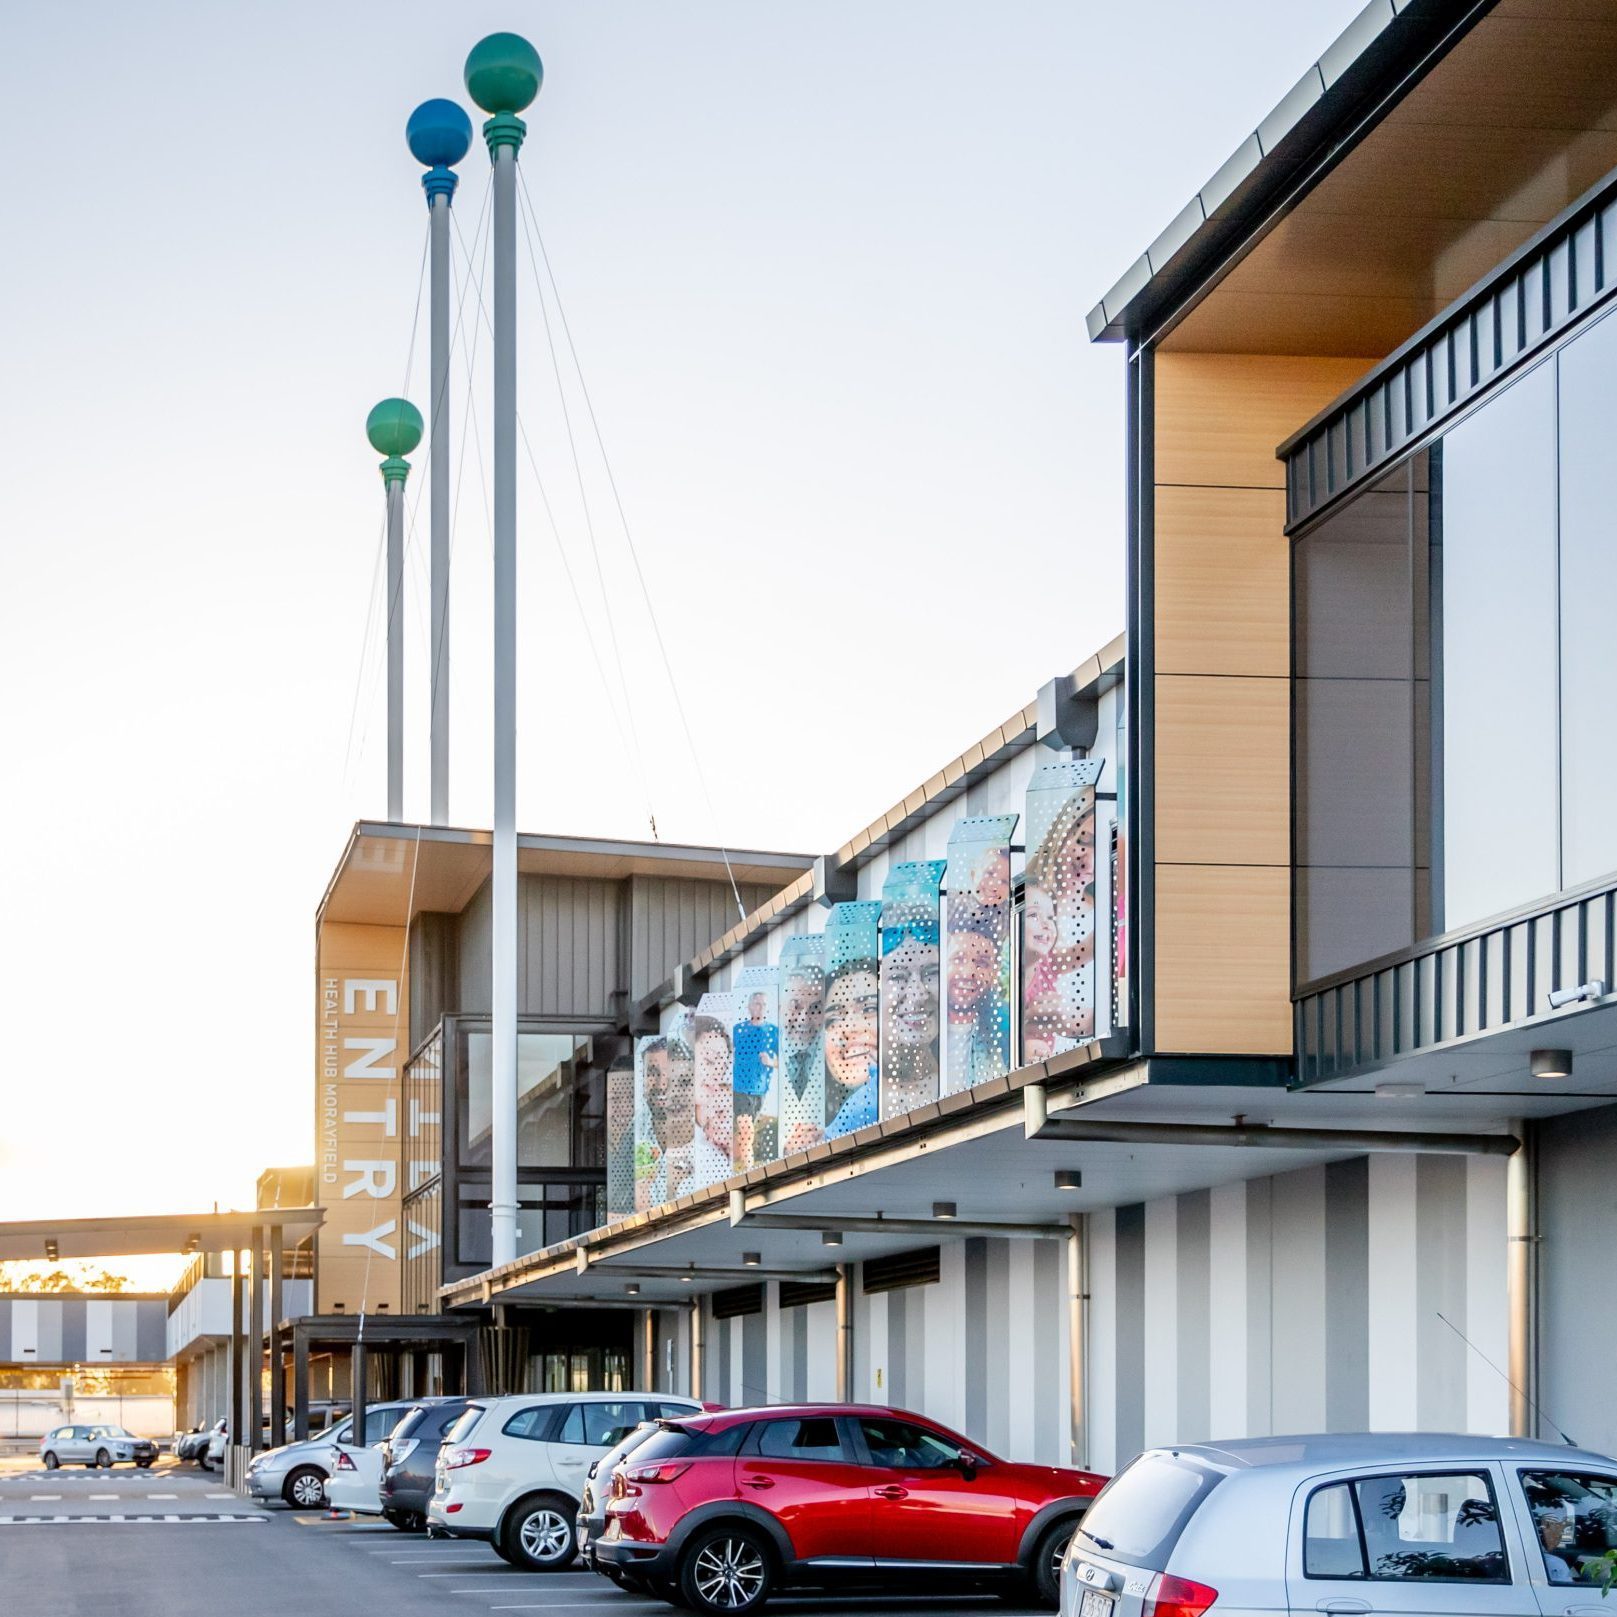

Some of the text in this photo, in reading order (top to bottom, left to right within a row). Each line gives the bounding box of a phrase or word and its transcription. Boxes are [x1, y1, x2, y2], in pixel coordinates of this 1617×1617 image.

[324, 978, 338, 1184] HEALTH HUB MORAYFIELD
[343, 978, 397, 1260] ENTRY
